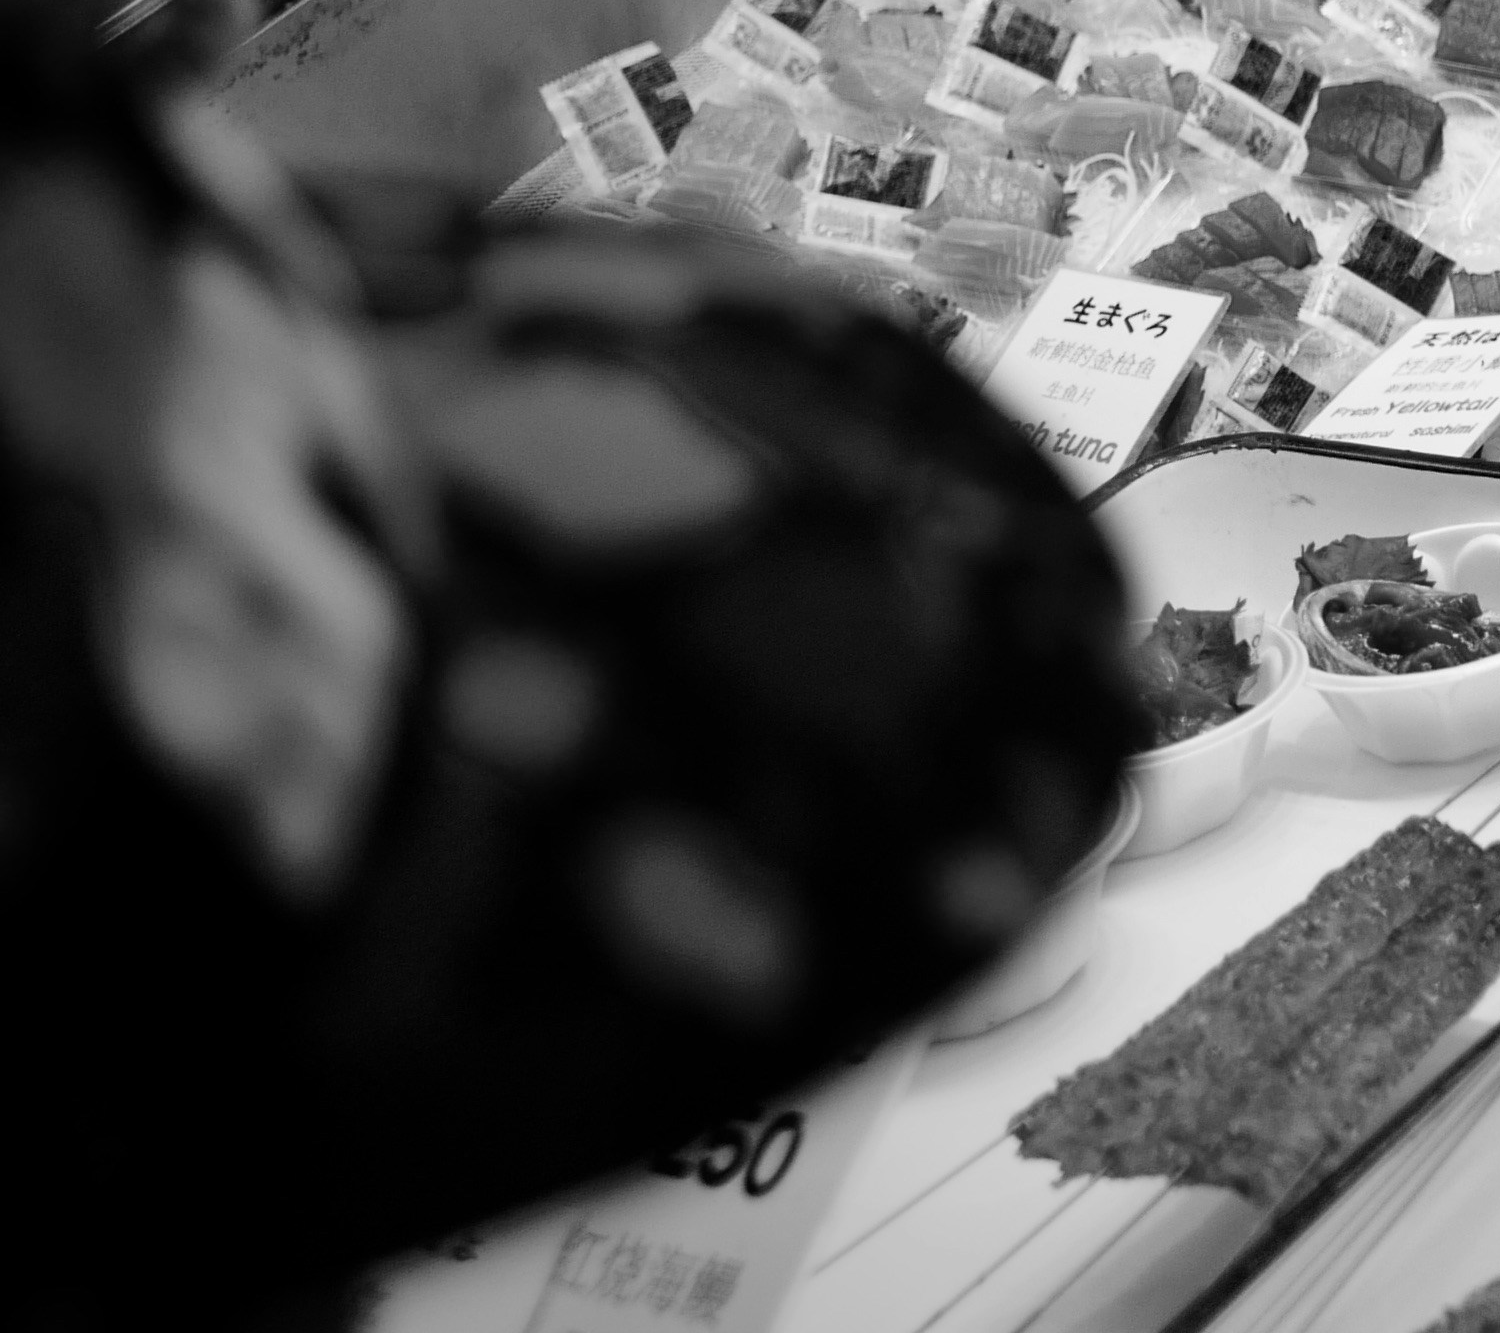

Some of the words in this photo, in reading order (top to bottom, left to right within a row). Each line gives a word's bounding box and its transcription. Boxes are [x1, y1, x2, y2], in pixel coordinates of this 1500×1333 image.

[1063, 296, 1173, 339] 生まぐろ
[1385, 396, 1500, 416] Yellowtail
[1053, 427, 1119, 465] tuna
